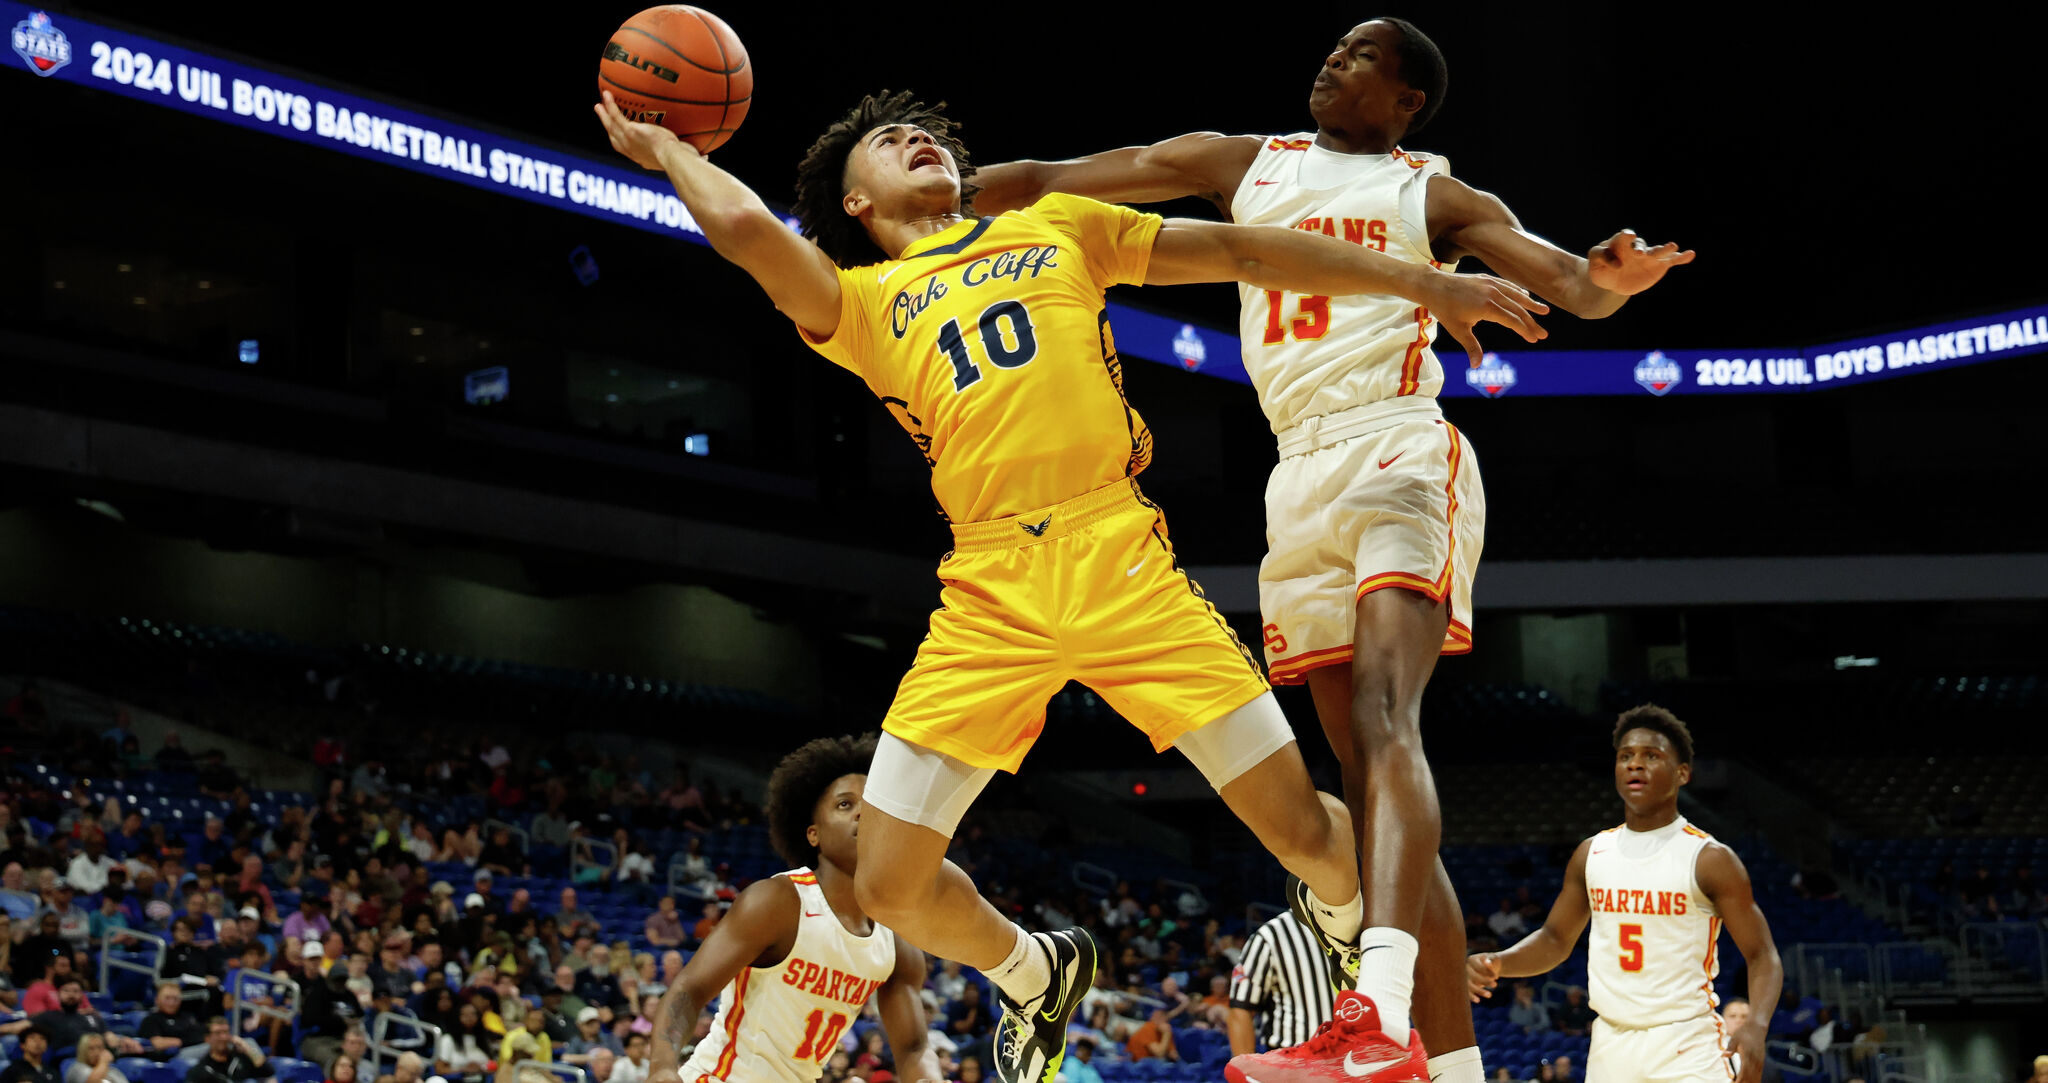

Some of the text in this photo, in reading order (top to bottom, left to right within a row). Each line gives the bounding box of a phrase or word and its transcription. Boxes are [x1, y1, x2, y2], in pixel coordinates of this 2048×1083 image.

[14, 30, 70, 62] STATE
[91, 41, 705, 236] 2024 UIL BOYS BASKETBALL STATE CHAMPION
[892, 245, 1058, 339] Oak Cliff
[1262, 289, 1332, 346] 13
[936, 299, 1039, 394] 10
[1695, 316, 2048, 386] 2024 UIL BOYS BASKETBALL
[1590, 887, 1688, 916] SPARTANS
[1618, 923, 1644, 973] 5
[792, 1008, 848, 1064] 10
